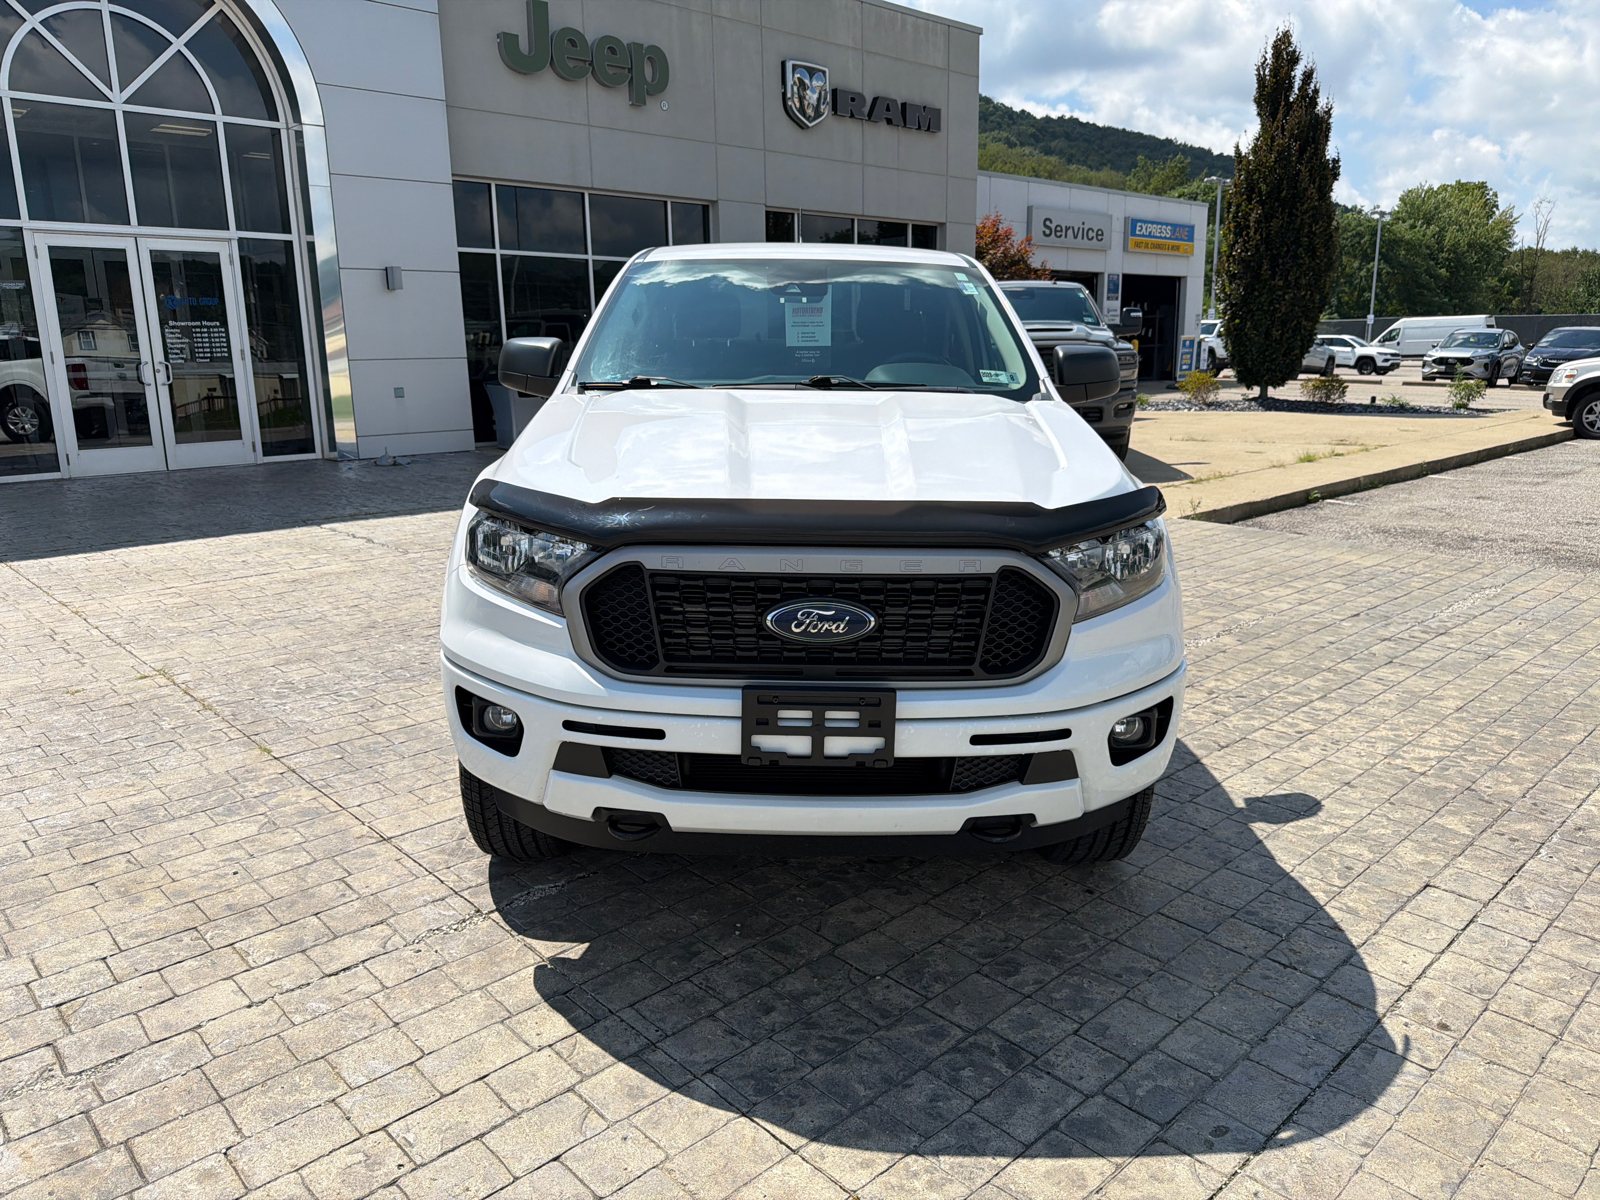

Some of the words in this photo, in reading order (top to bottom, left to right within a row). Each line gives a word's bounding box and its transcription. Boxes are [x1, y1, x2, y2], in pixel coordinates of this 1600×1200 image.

[497, 0, 669, 107] Jeep
[832, 87, 941, 133] RAM
[1042, 217, 1104, 242] Service
[1134, 241, 1144, 249] FAST
[1150, 242, 1167, 251] CHANGES
[1171, 244, 1181, 252] MORE
[199, 297, 219, 305] GROUP
[660, 555, 982, 572] RANGER
[791, 608, 850, 633] Ford
